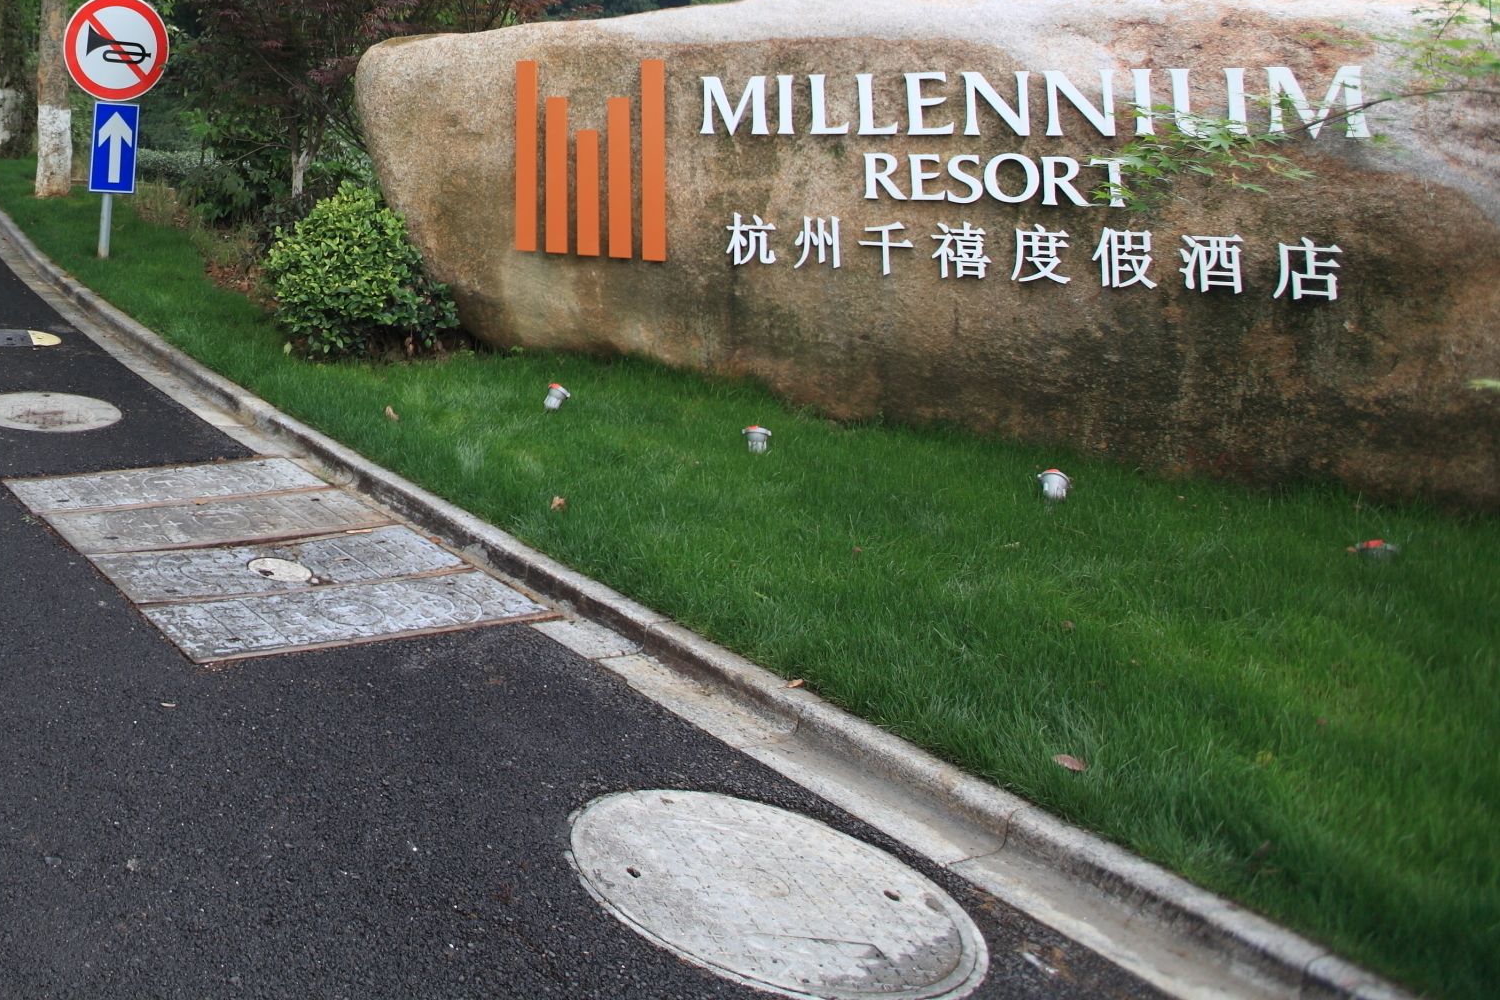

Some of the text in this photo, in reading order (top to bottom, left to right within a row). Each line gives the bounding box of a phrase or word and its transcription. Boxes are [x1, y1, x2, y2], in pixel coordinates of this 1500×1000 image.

[700, 65, 1370, 139] MILLENNIUM
[863, 152, 1128, 208] RESORT
[725, 212, 1342, 302] 杭州千禧度假酒店
